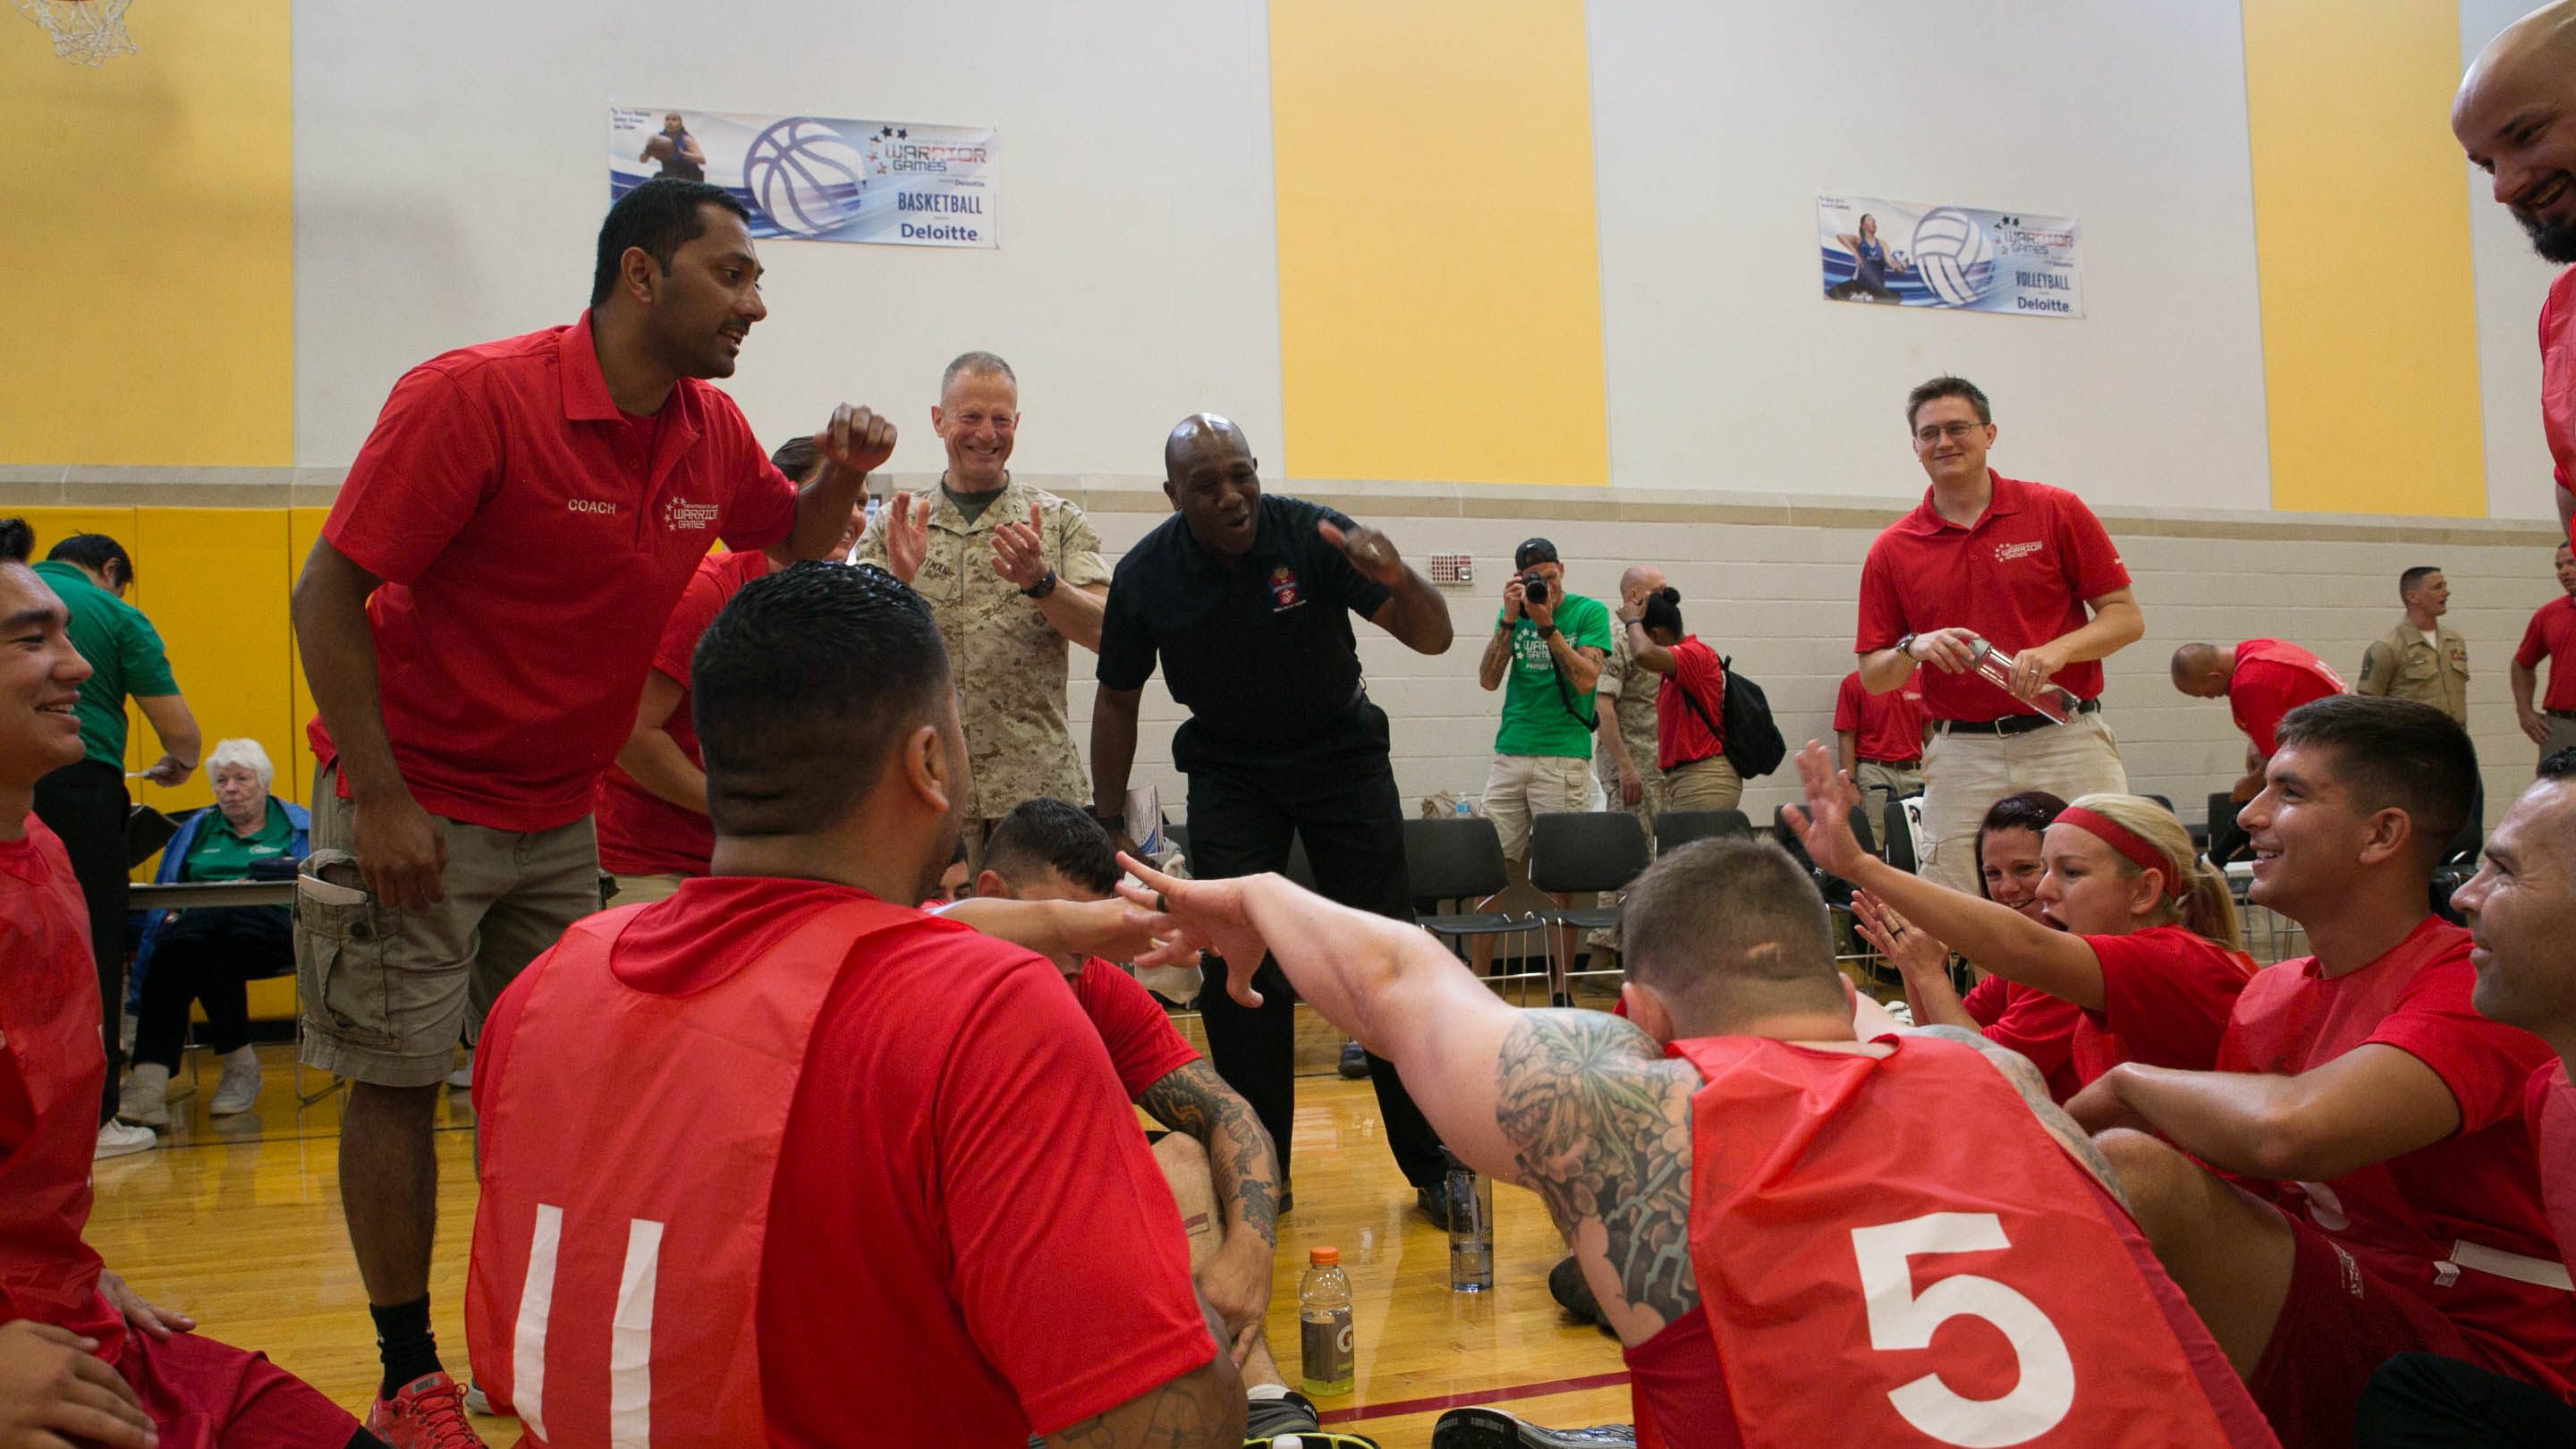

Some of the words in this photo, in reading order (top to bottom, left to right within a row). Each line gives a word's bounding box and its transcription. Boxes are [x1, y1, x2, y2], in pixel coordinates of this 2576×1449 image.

[885, 144, 987, 164] WARRIOR
[893, 159, 947, 172] GAMES
[898, 192, 983, 214] BASKETBALL
[2016, 271, 2070, 291] VOLLEYBALL
[568, 499, 616, 515] COACH
[678, 520, 706, 530] GAMES
[513, 1203, 664, 1449] 11
[1851, 1212, 2075, 1448] 5
